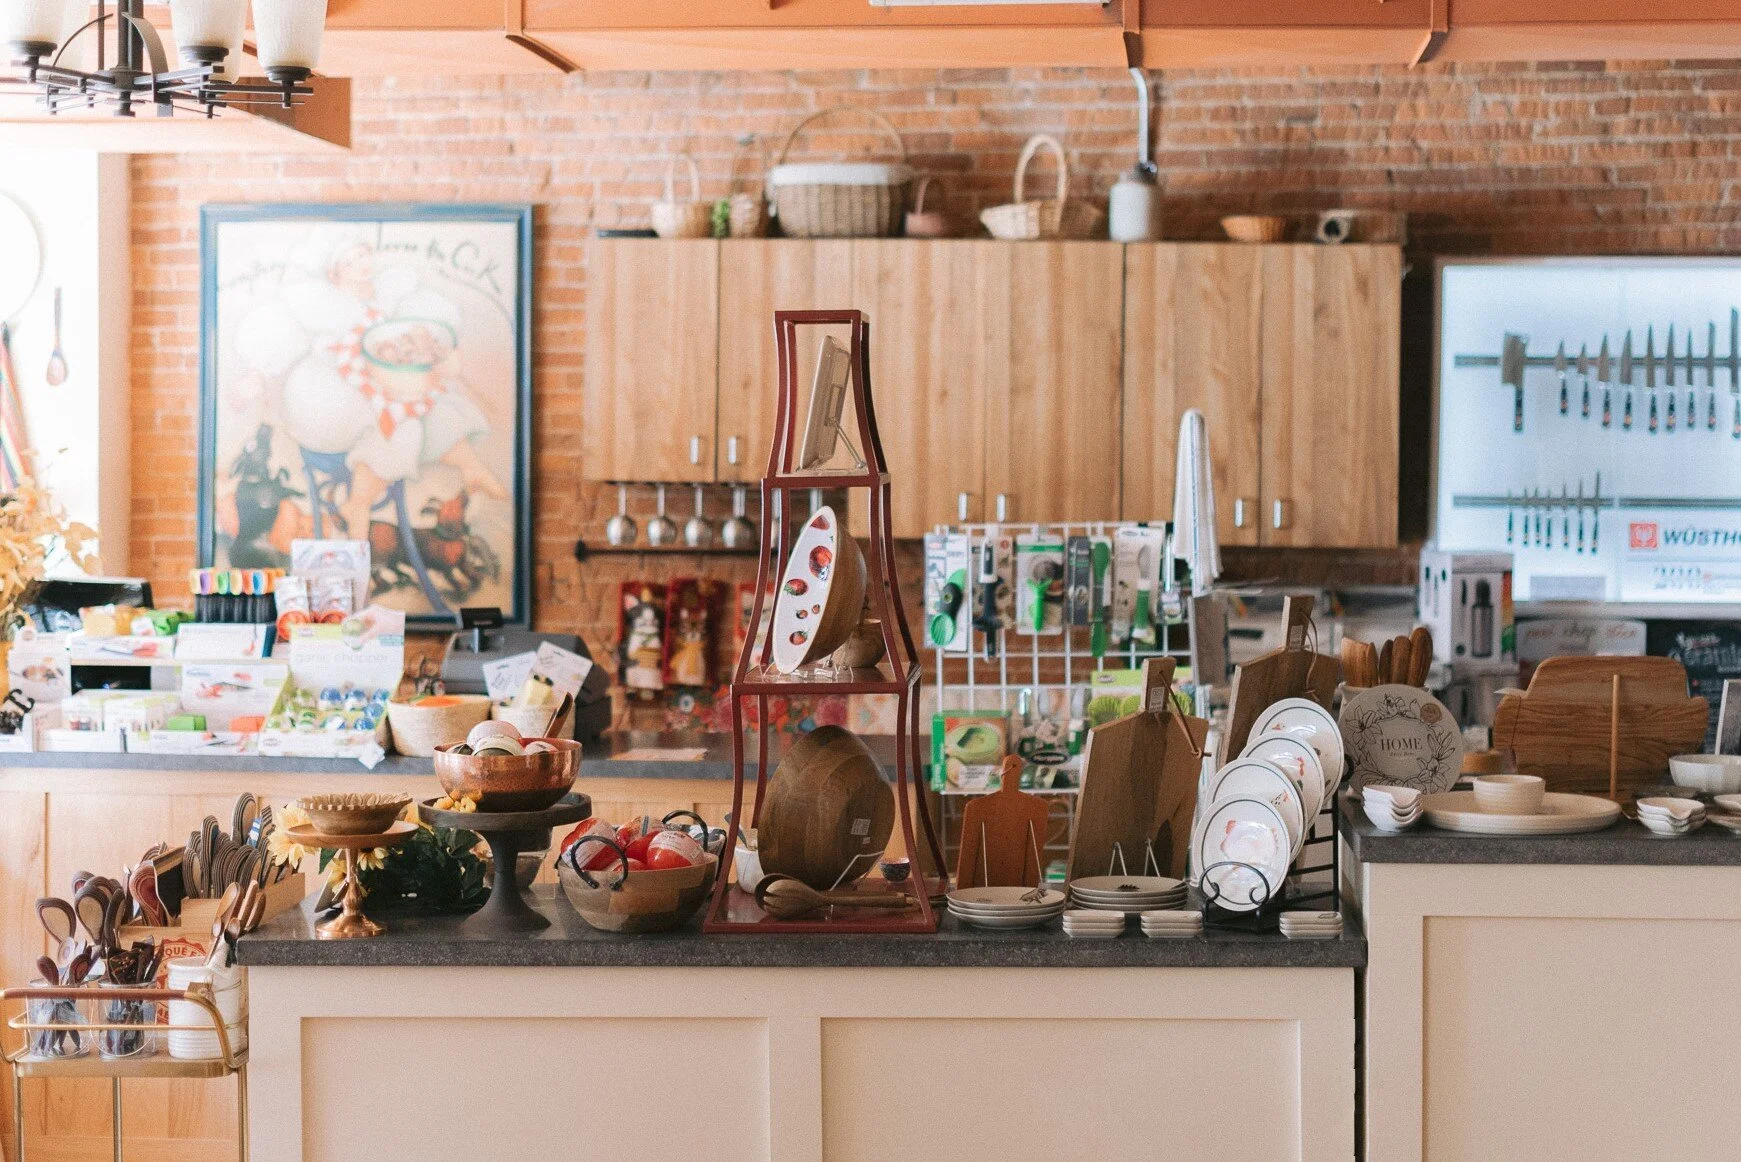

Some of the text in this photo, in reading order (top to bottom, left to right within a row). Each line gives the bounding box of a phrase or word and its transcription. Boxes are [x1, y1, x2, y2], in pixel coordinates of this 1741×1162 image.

[1664, 526, 1741, 545] WÜSTH
[1381, 738, 1422, 750] HOME
[165, 946, 187, 956] QUE
